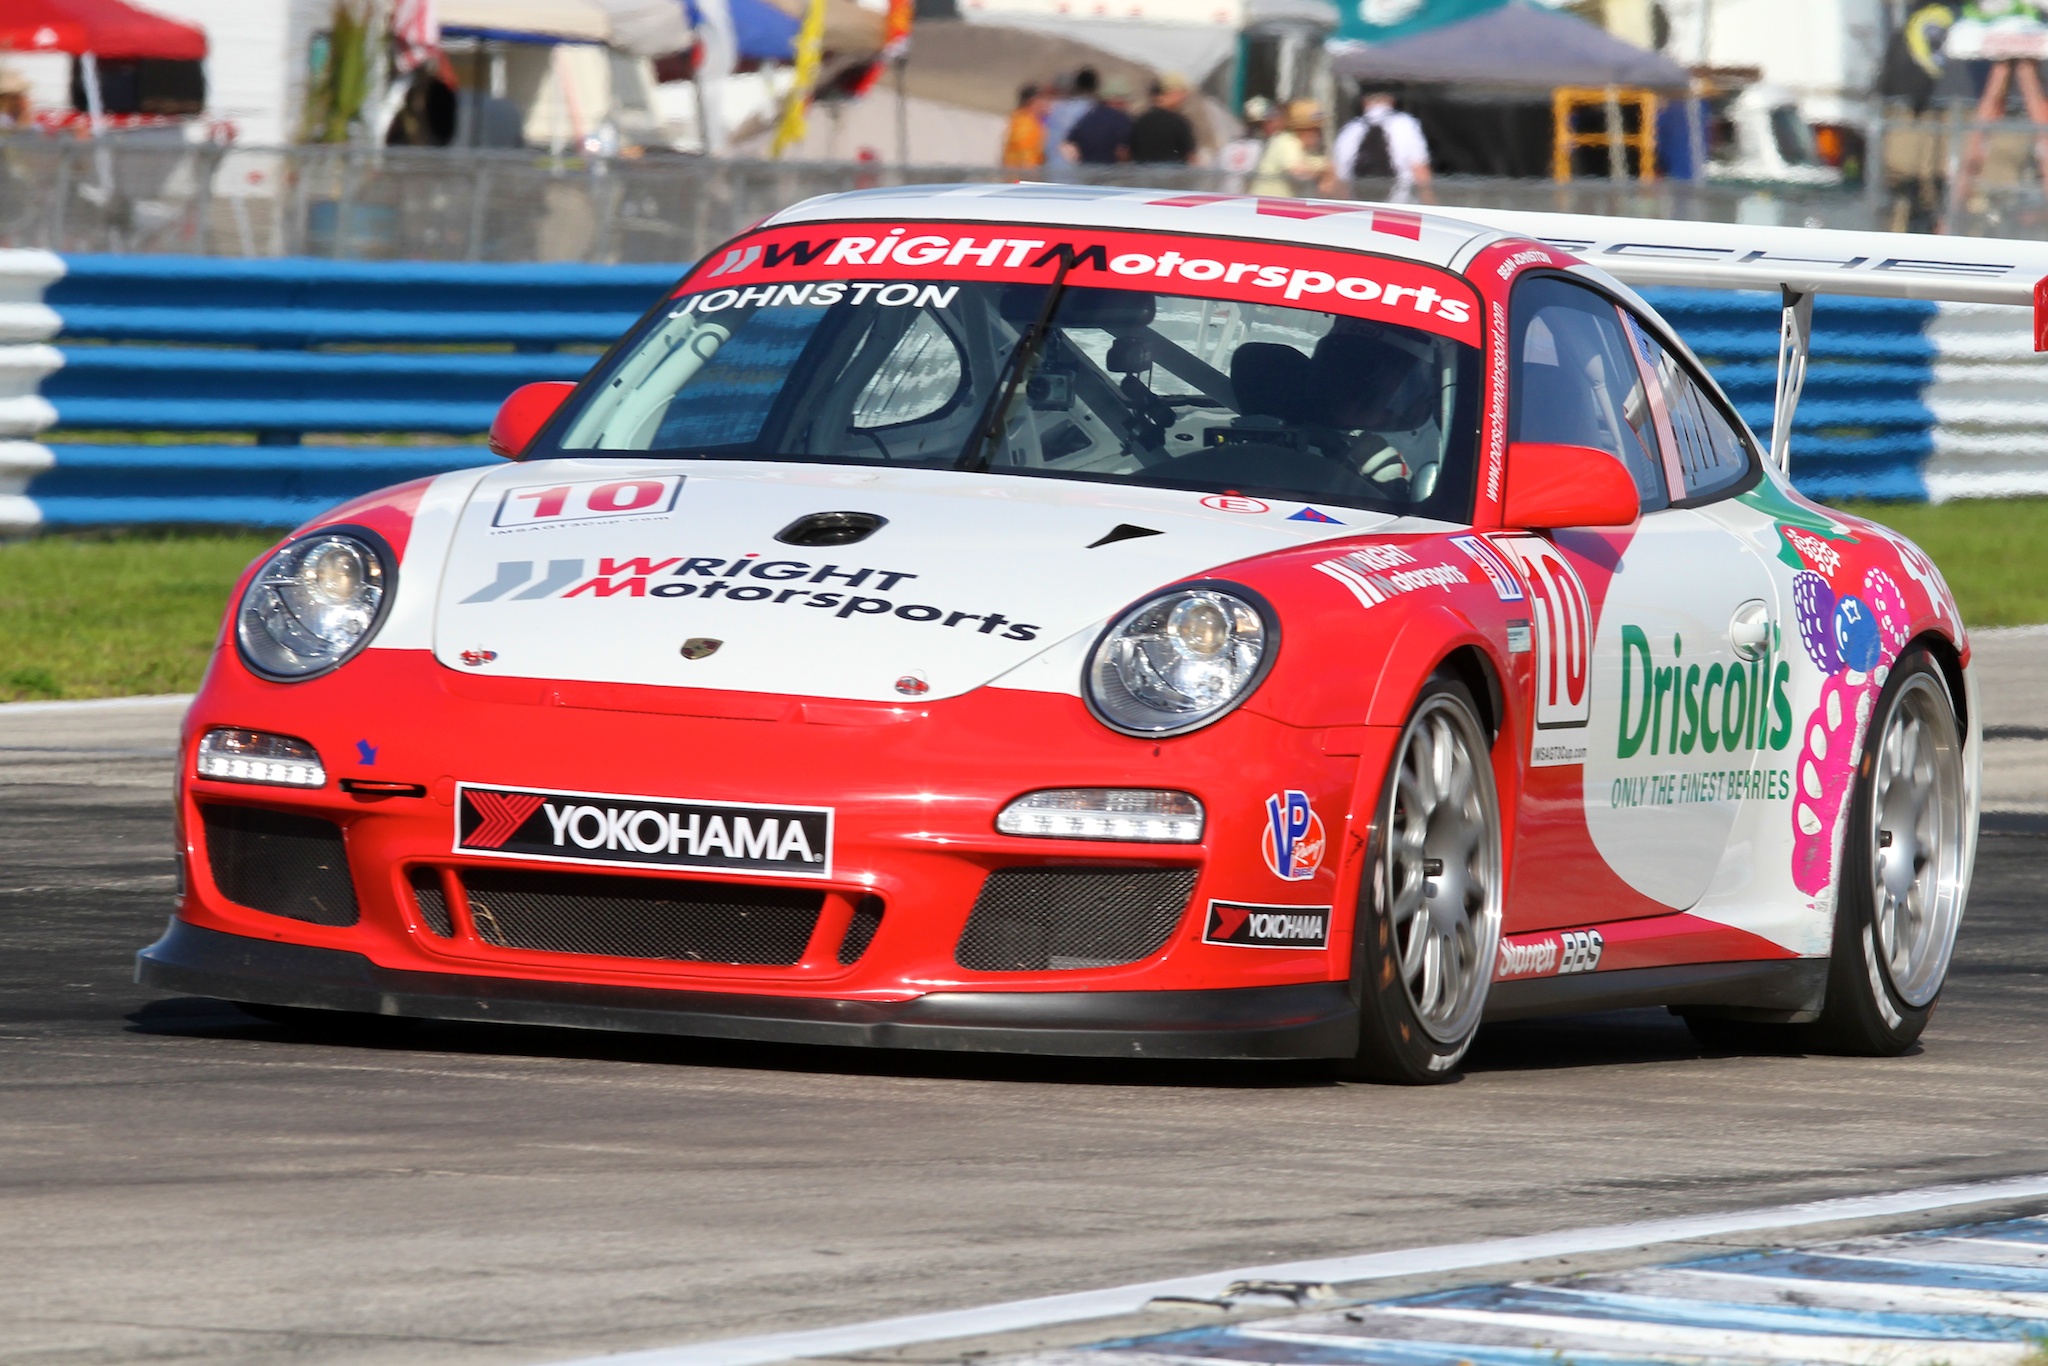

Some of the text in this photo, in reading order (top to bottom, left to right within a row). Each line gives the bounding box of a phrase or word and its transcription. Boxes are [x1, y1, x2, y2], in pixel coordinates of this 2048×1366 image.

[1496, 250, 1552, 281] SEAN JOHNSTON
[668, 283, 960, 320] JOHNSTON
[517, 481, 664, 518] 10
[1367, 561, 1469, 598] Motorsports
[560, 576, 1042, 642] Motorsports
[1520, 554, 1588, 706] 10
[1611, 769, 1790, 809] ONLY THE FINEST BERRIES
[541, 802, 816, 864] YOKOHAMA
[1265, 789, 1311, 878] VP
[1248, 913, 1323, 939] YOKOHAMA
[1557, 928, 1604, 975] BBS
